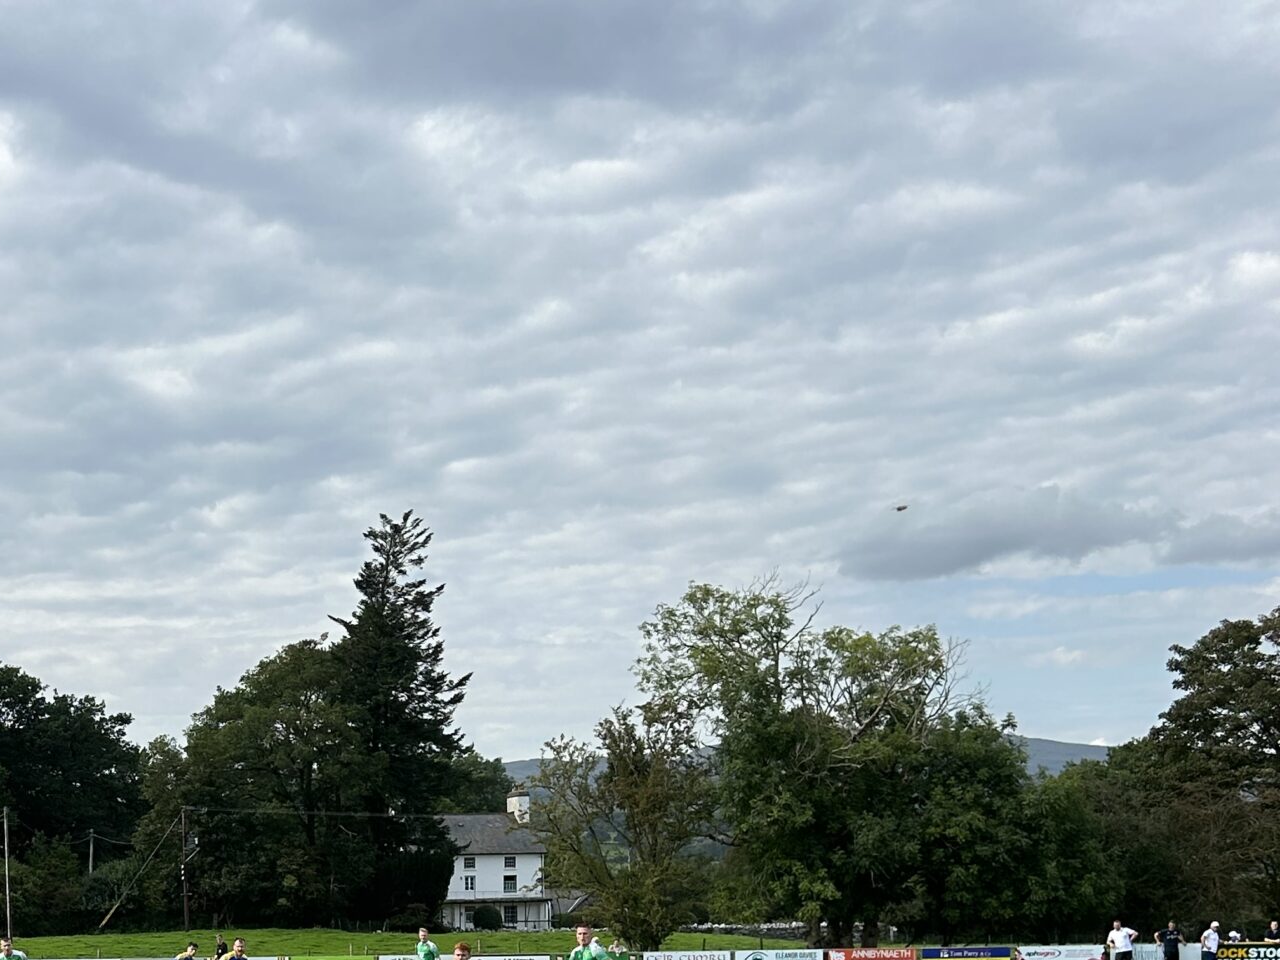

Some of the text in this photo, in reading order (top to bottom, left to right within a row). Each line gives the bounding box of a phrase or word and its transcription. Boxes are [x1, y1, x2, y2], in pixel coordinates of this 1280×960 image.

[828, 950, 846, 960] Yes
[851, 950, 911, 958] ANNIBYNIAETH
[1217, 948, 1280, 958] OCKSTO
